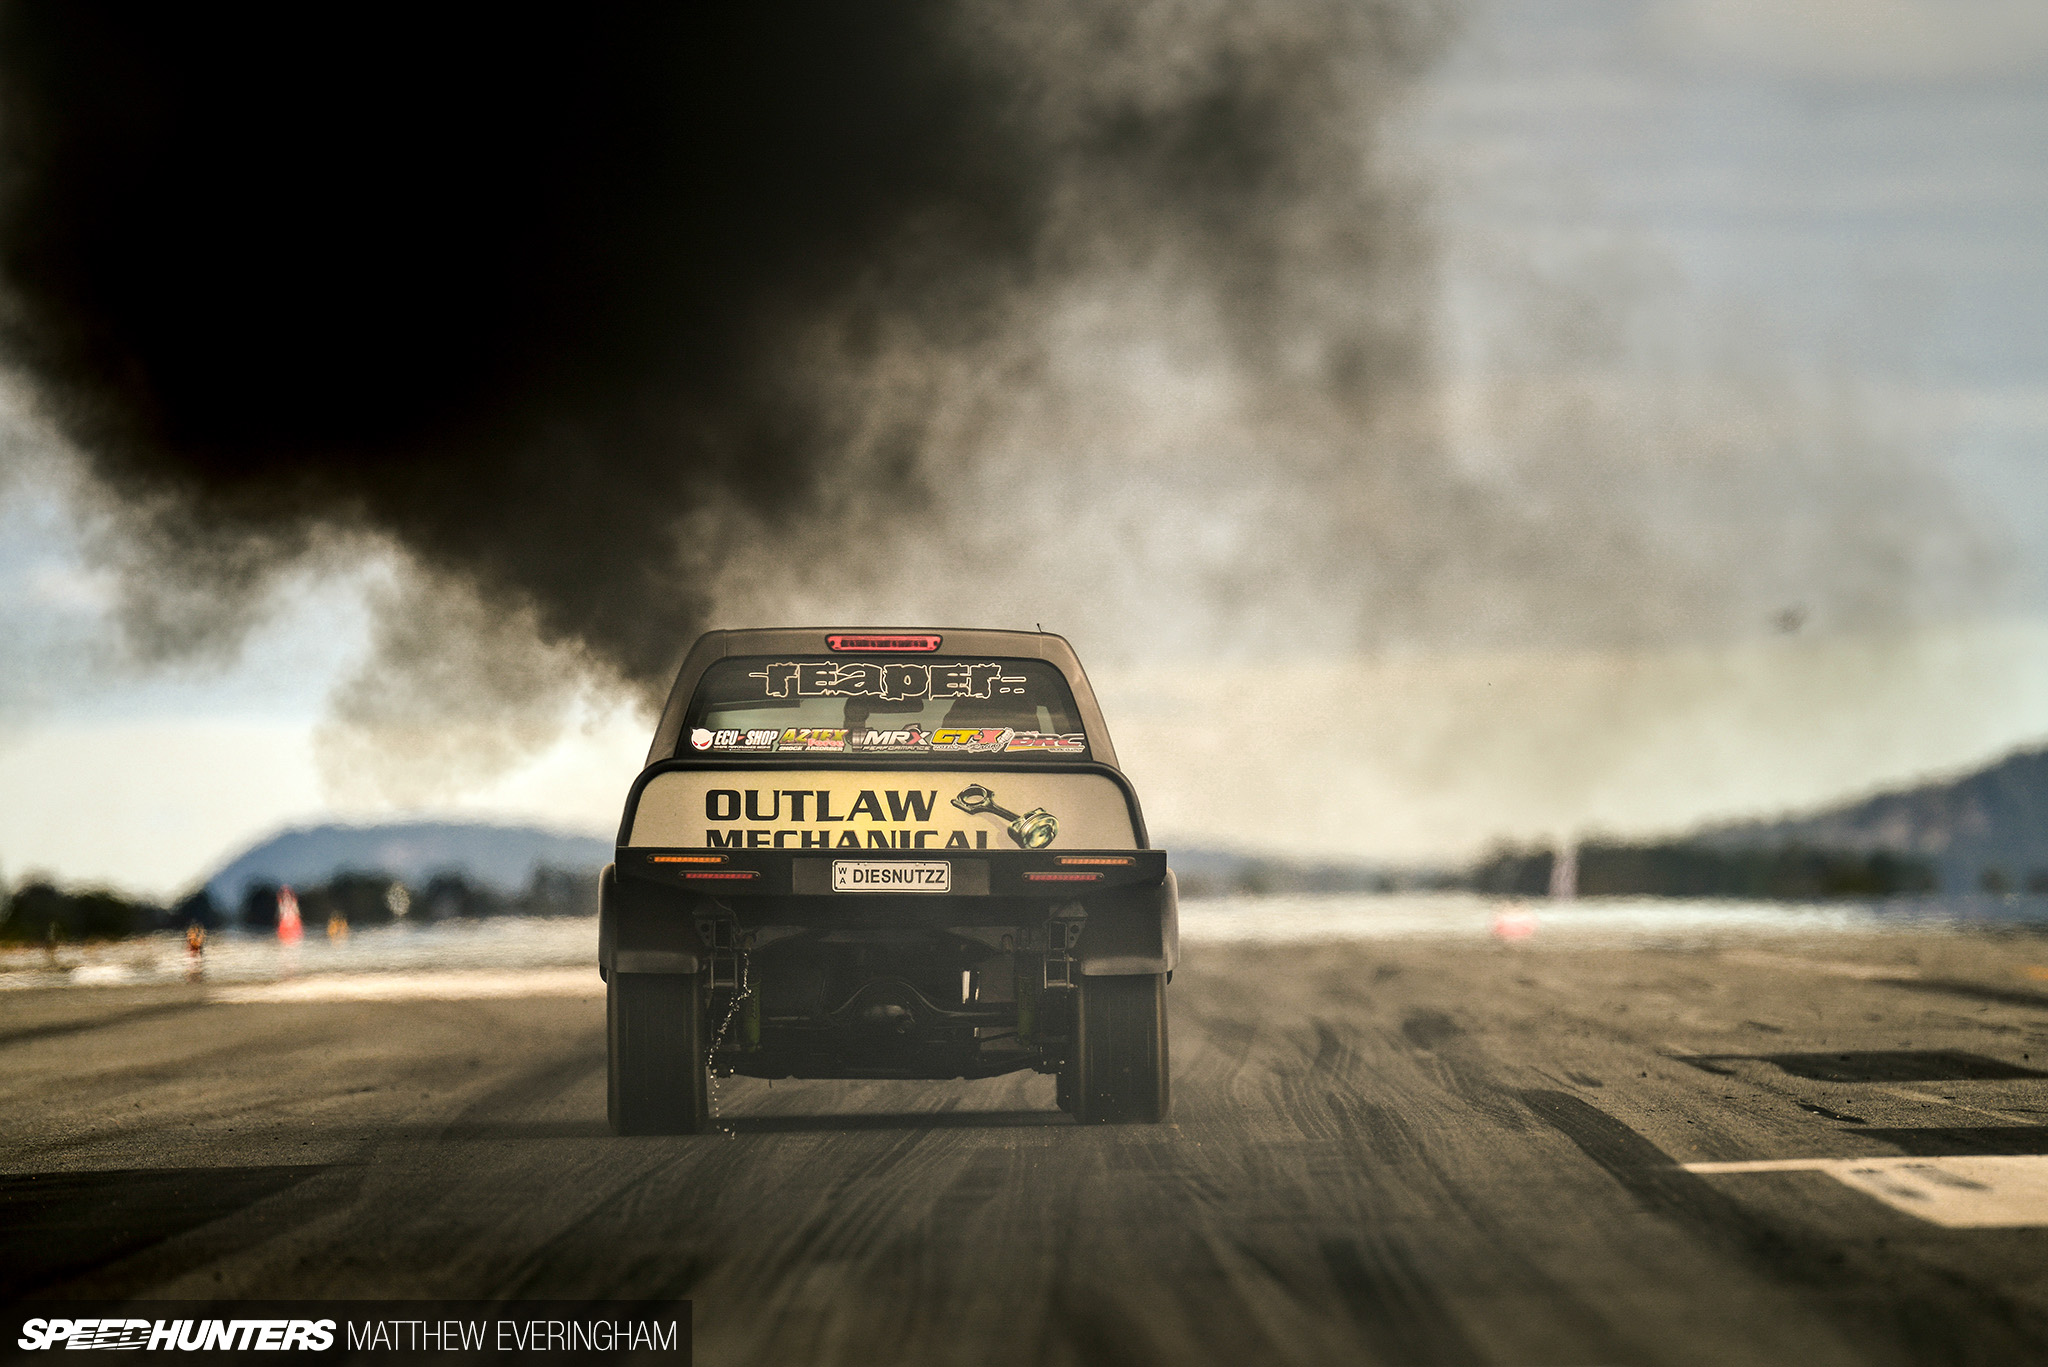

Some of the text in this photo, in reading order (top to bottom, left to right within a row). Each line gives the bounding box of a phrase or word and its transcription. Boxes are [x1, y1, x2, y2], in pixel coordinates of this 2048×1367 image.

[863, 730, 931, 745] MRX
[705, 789, 938, 822] OUTLAW
[853, 869, 946, 884] DIESNUTZZ
